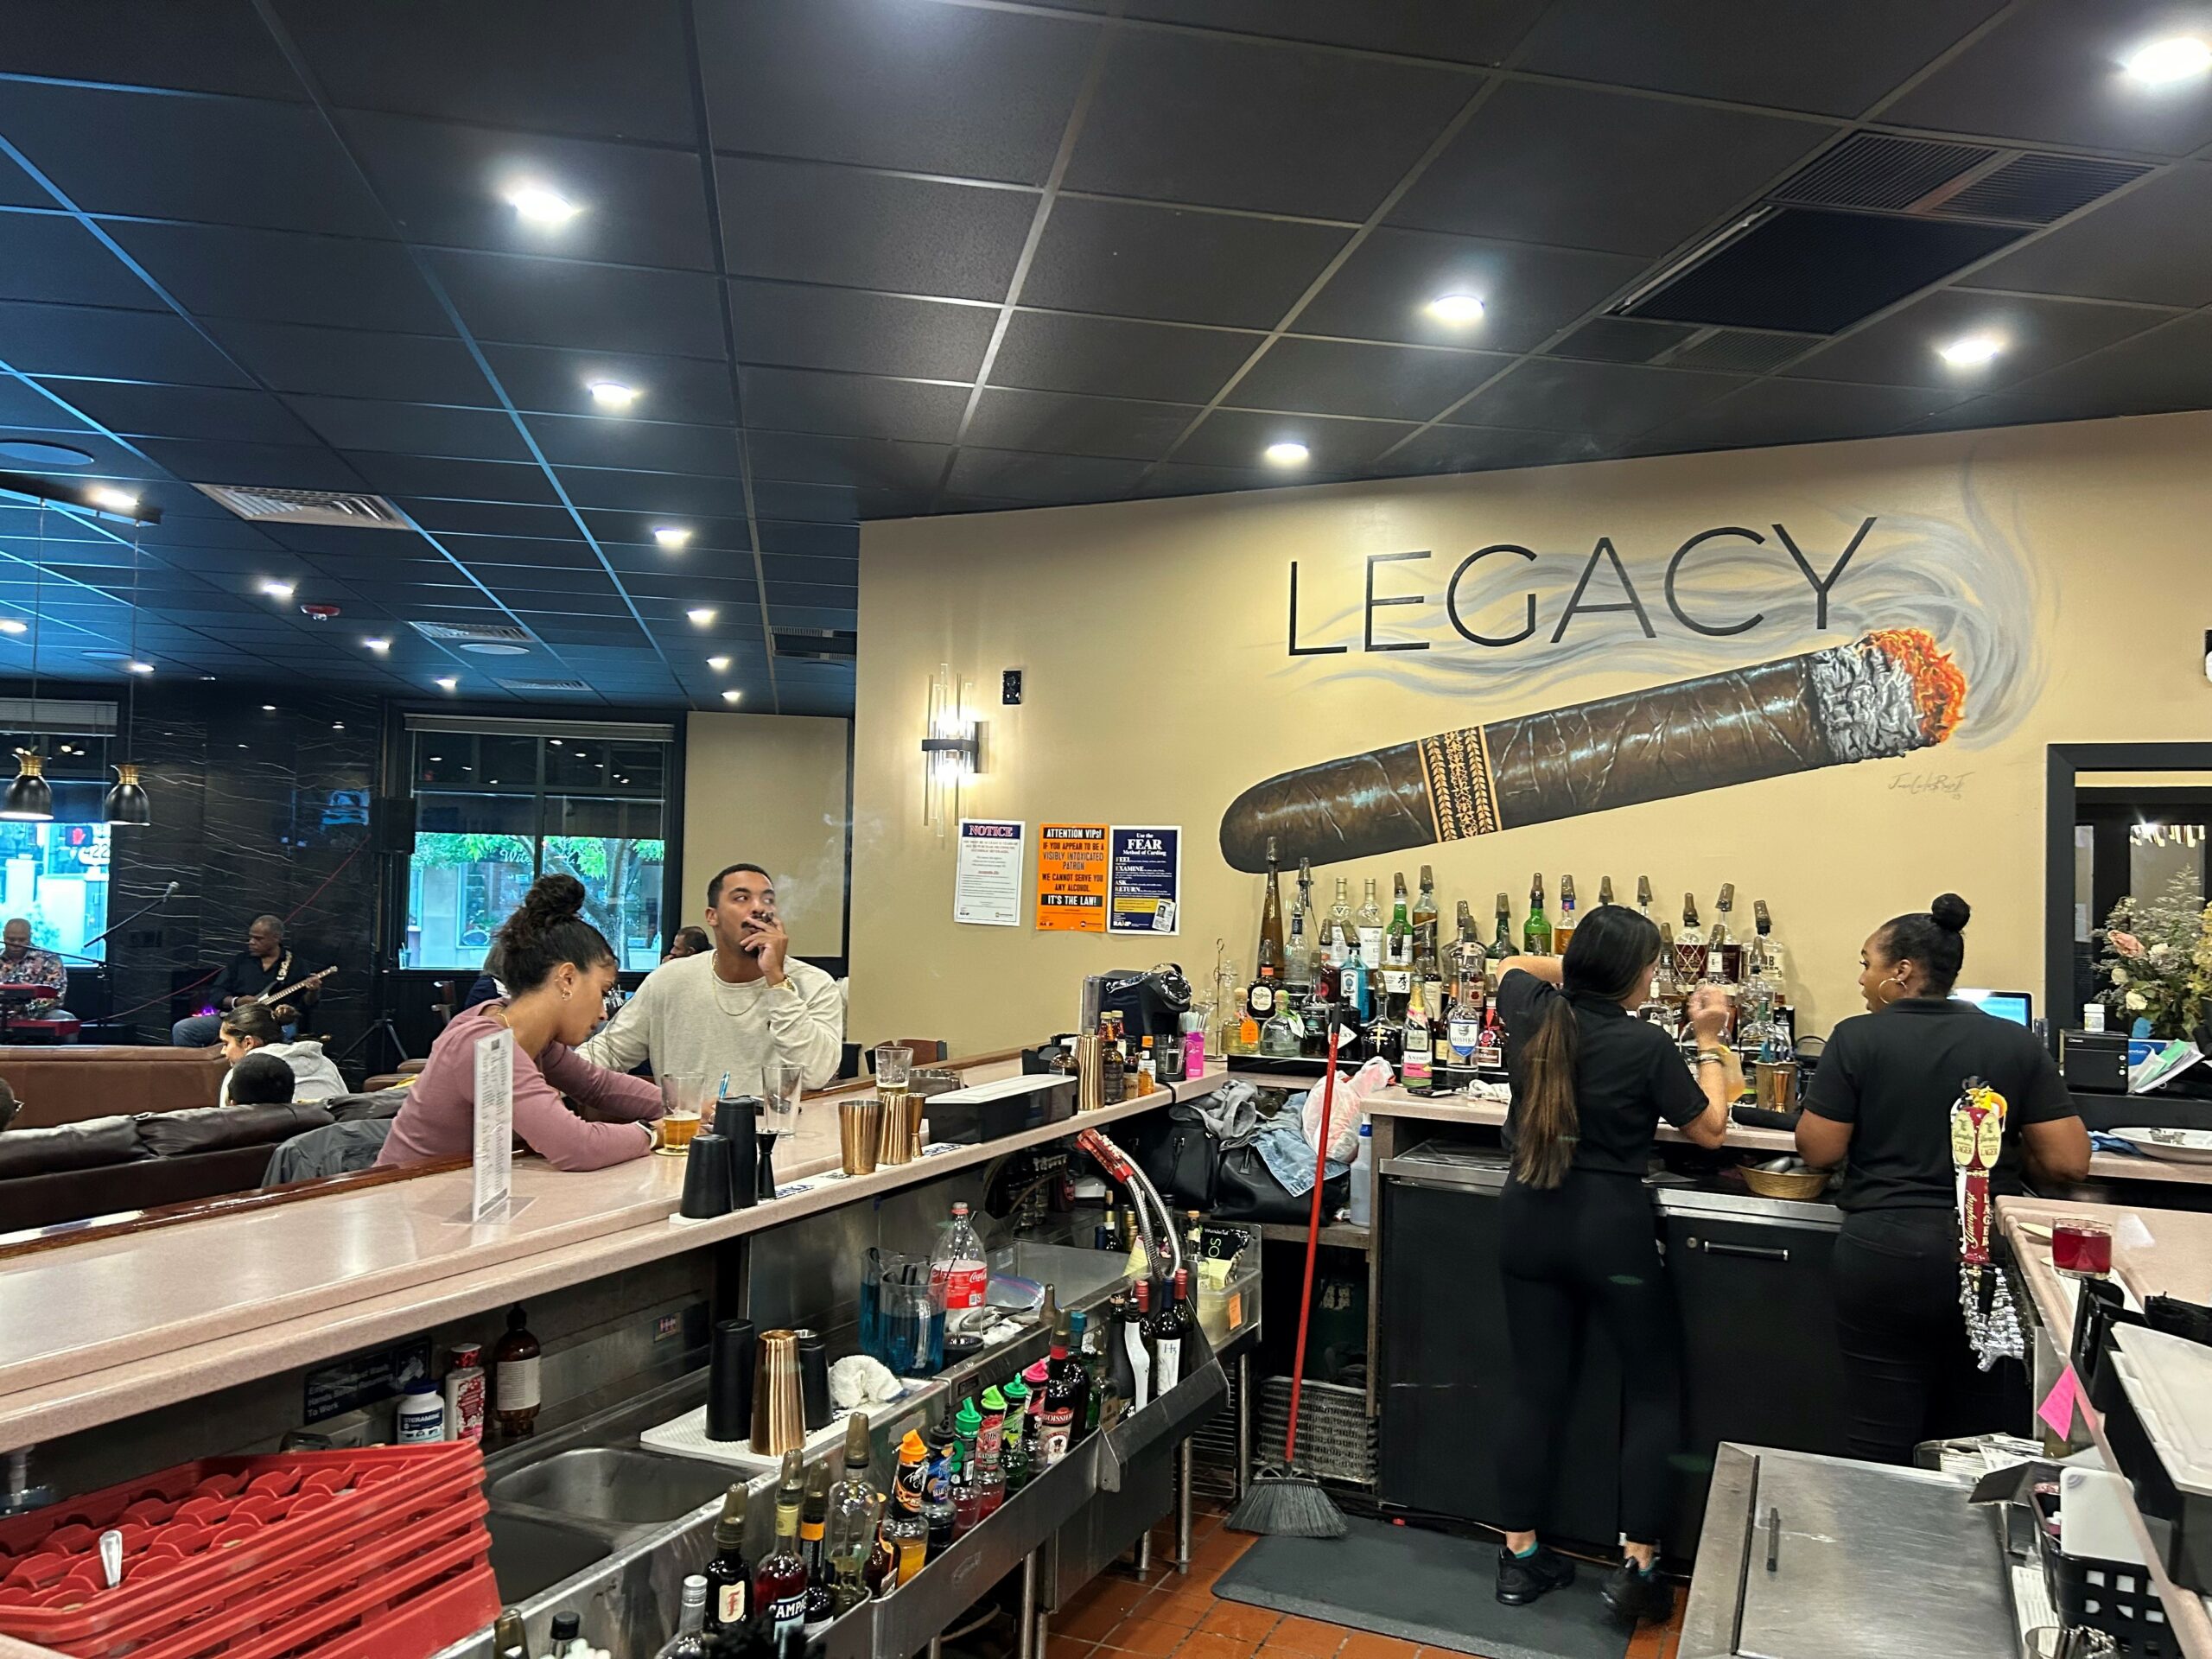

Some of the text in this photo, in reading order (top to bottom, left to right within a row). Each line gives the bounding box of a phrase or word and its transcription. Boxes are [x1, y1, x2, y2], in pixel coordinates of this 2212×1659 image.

[1288, 517, 1877, 656] LEGACY
[969, 825, 1014, 837] NOTICE
[1046, 829, 1102, 838] ATTENTION VIPs!
[1127, 839, 1162, 850] FEAR
[1067, 852, 1103, 861] INTOXICATED
[1063, 861, 1084, 870] PATRON
[1048, 895, 1096, 906] IT'S THE LAW!
[1955, 1145, 1972, 1154] LAGER
[1965, 1190, 1979, 1249] Yuengling
[1981, 1193, 1992, 1247] LAGER
[307, 1402, 339, 1417] To Work
[403, 1412, 441, 1423] STERAMINE
